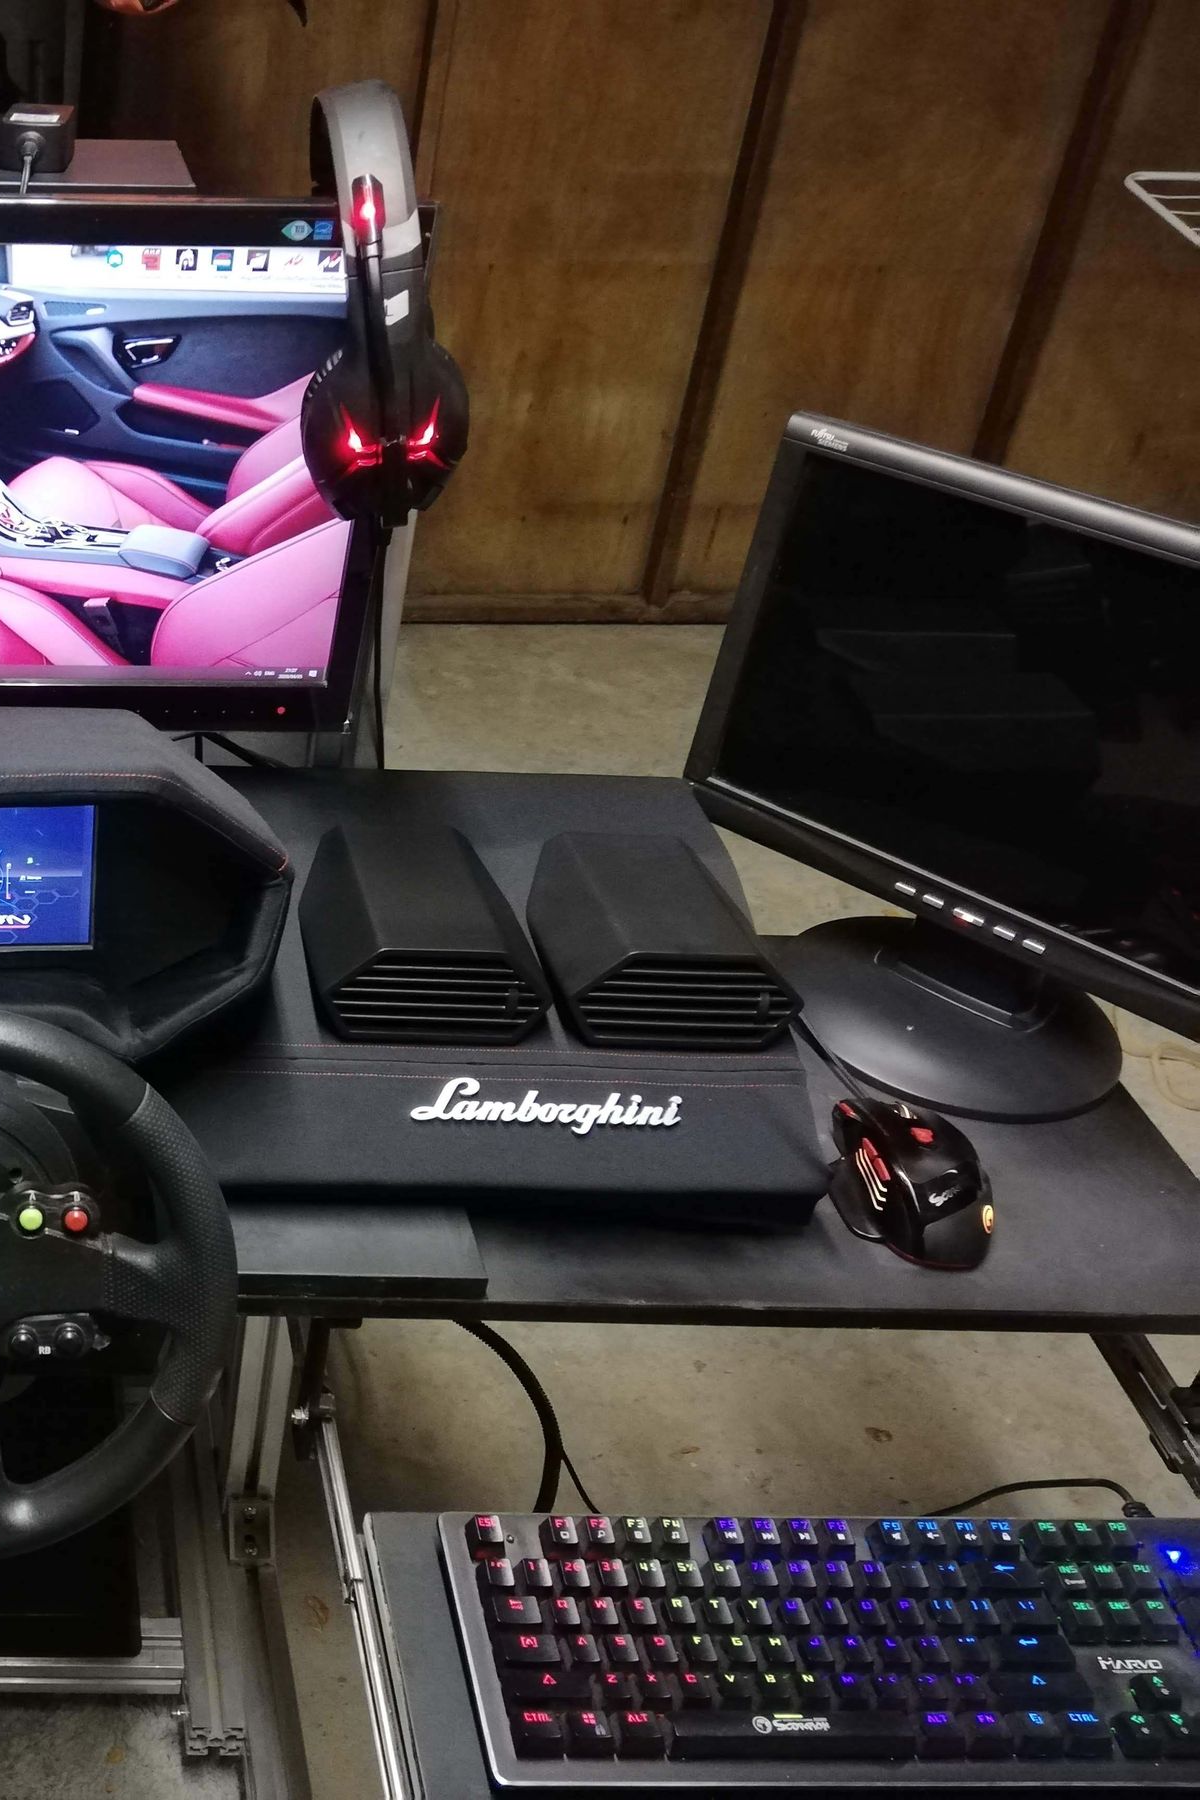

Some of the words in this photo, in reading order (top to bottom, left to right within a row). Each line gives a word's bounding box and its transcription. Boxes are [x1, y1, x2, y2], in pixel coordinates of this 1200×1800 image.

[410, 1077, 682, 1135] Lamborghini
[38, 1346, 51, 1355] RB
[589, 1519, 607, 1528] F2
[626, 1519, 644, 1528] F3
[662, 1519, 680, 1528] F4
[791, 1521, 809, 1530] F7
[882, 1521, 901, 1531] F9
[955, 1522, 974, 1531] F11
[990, 1522, 1010, 1531] F12
[671, 1598, 683, 1608] R
[709, 1600, 719, 1608] T
[748, 1600, 758, 1609] Y
[615, 1637, 626, 1645] S
[692, 1636, 702, 1645] F
[731, 1637, 744, 1646] G
[768, 1638, 781, 1646] H
[1097, 1656, 1163, 1670] MARVO
[646, 1674, 657, 1682] X
[724, 1674, 735, 1683] V
[801, 1674, 814, 1683] N
[627, 1713, 649, 1723] ALT
[1068, 1713, 1100, 1722] CTRL
